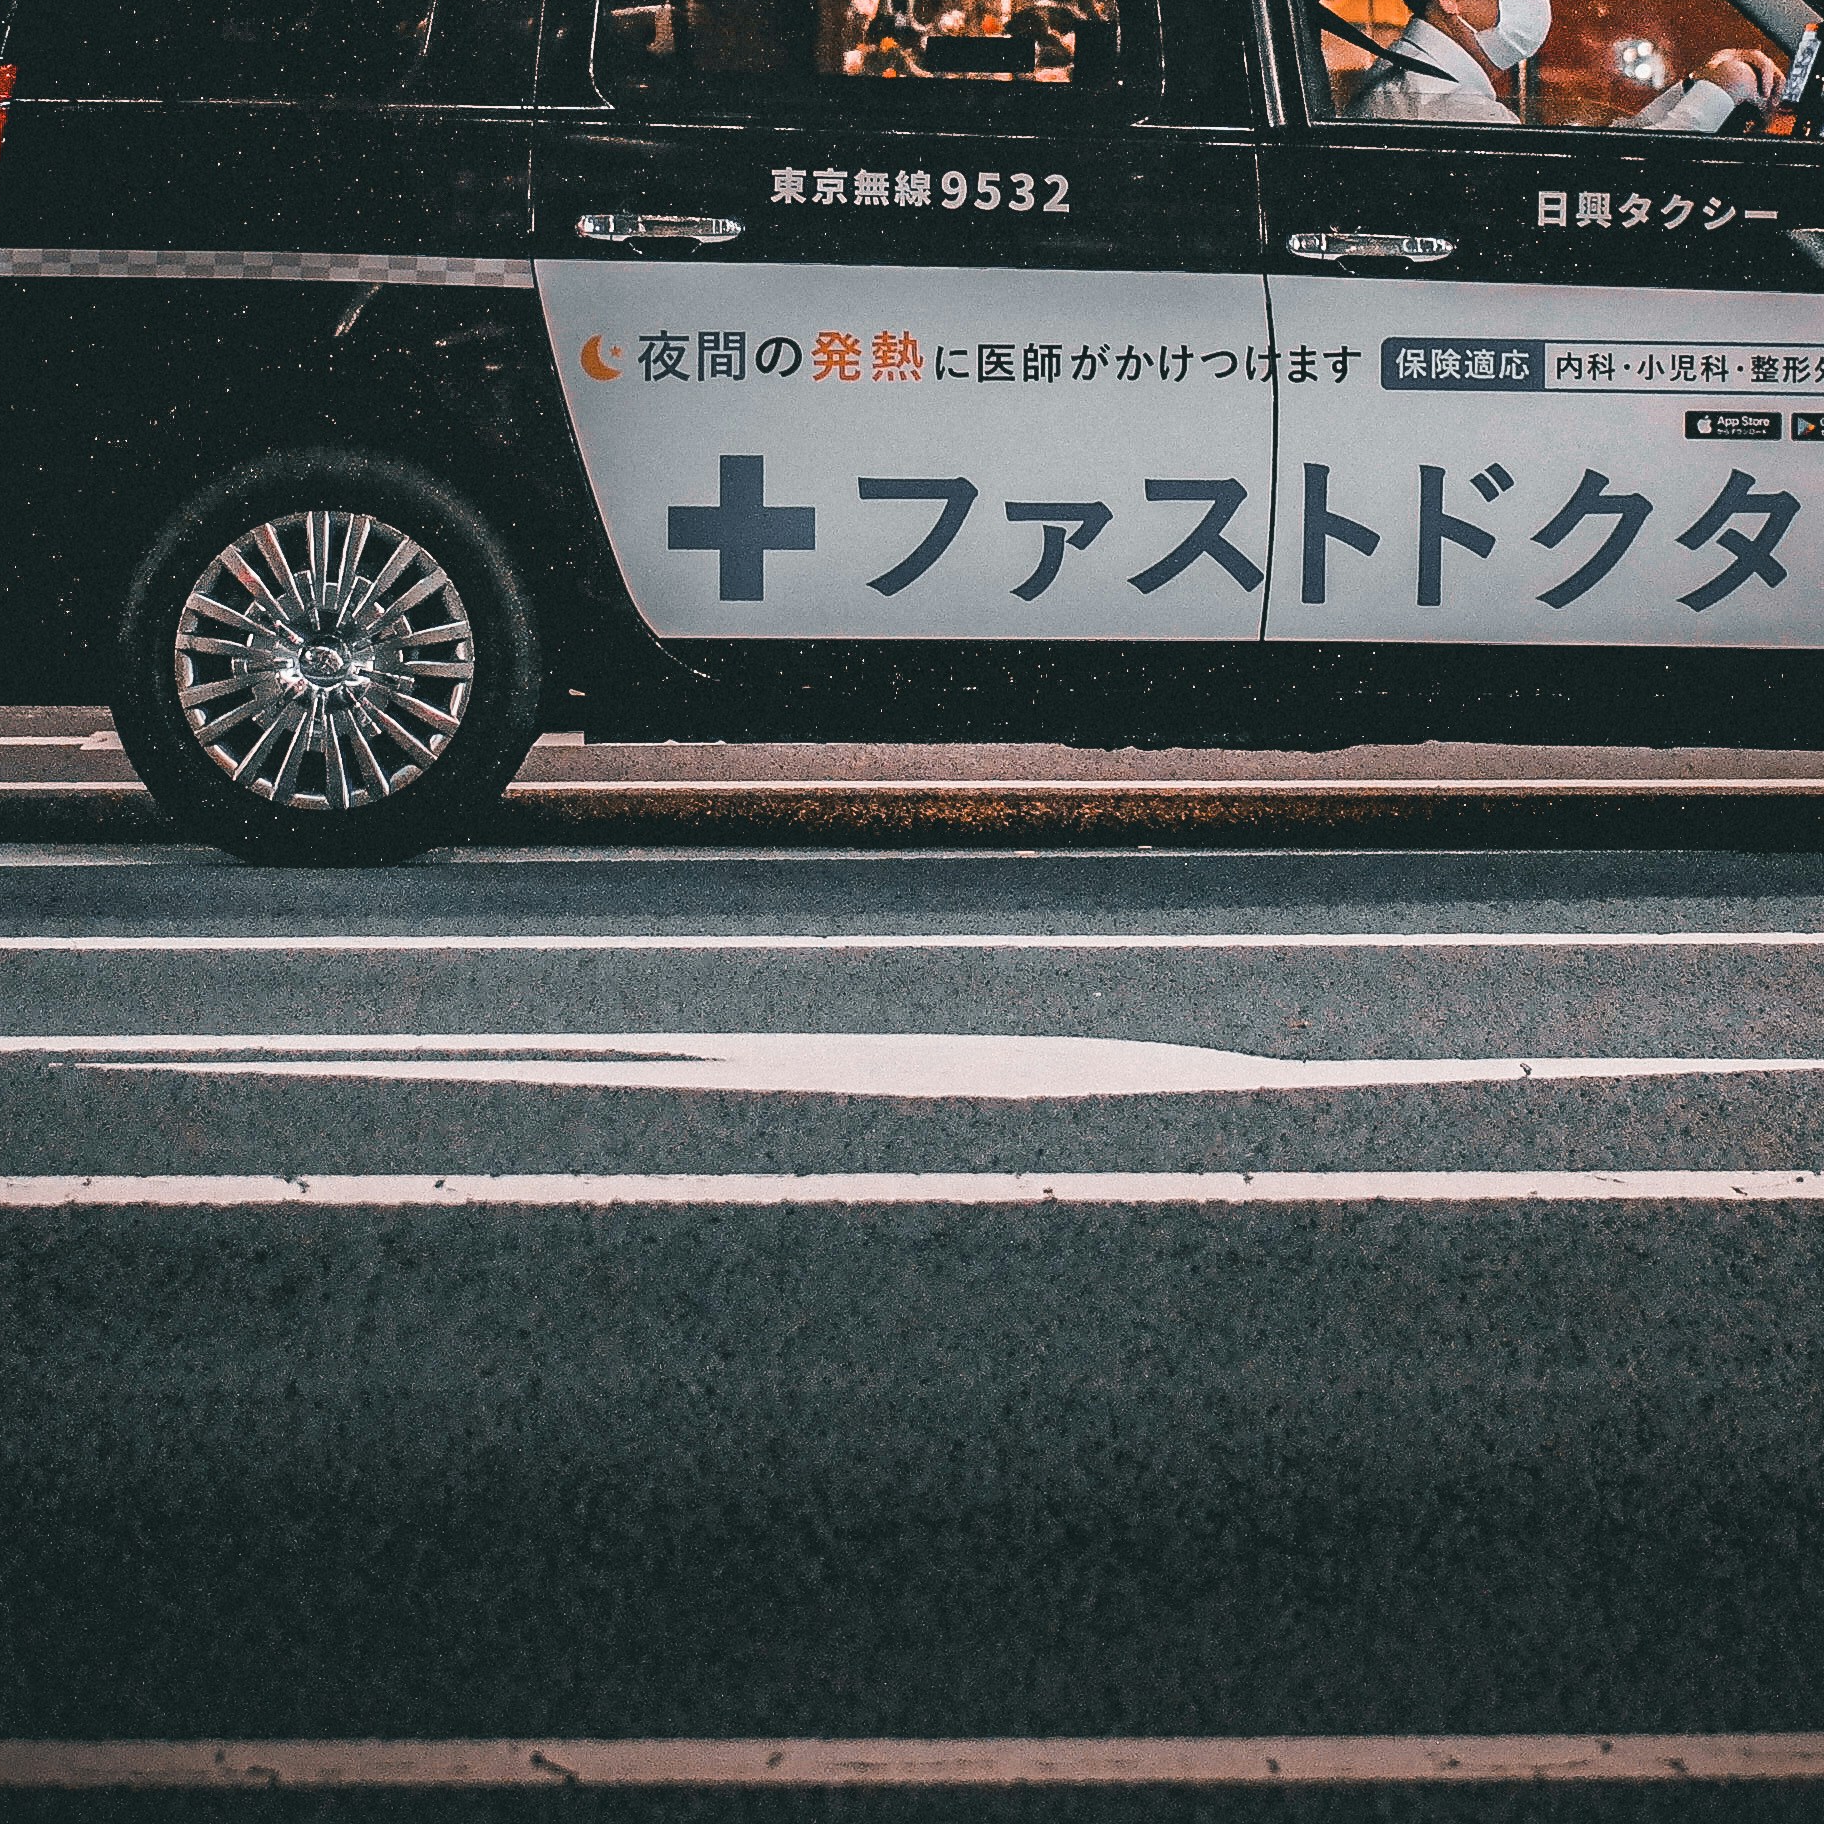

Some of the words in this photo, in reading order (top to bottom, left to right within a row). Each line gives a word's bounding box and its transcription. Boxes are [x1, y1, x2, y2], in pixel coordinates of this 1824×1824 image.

[770, 166, 1071, 213] 東京無線9532
[1537, 190, 1779, 231] 日興タクシー
[1395, 347, 1530, 380] 保険適応
[1716, 415, 1739, 427] App
[1742, 415, 1771, 427] Store
